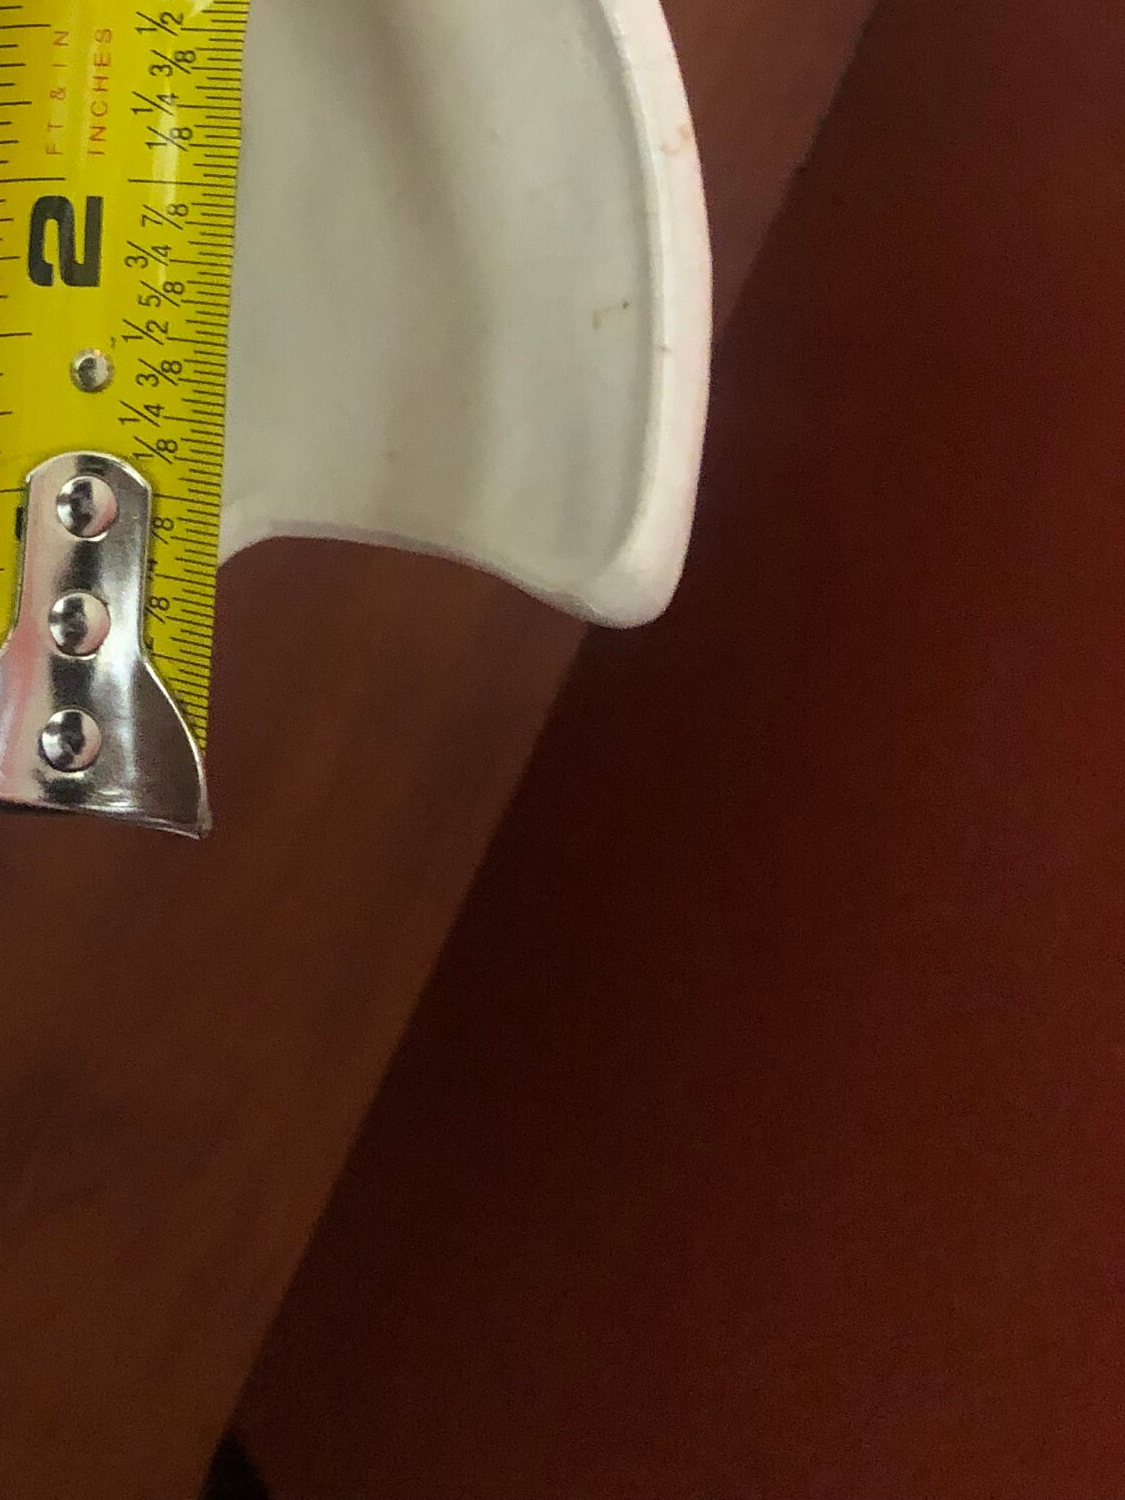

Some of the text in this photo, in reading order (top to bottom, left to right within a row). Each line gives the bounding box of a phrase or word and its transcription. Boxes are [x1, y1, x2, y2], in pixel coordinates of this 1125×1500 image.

[49, 86, 67, 102] &
[88, 28, 113, 156] INCHES
[45, 122, 64, 155] FT
[27, 195, 104, 287] 2
